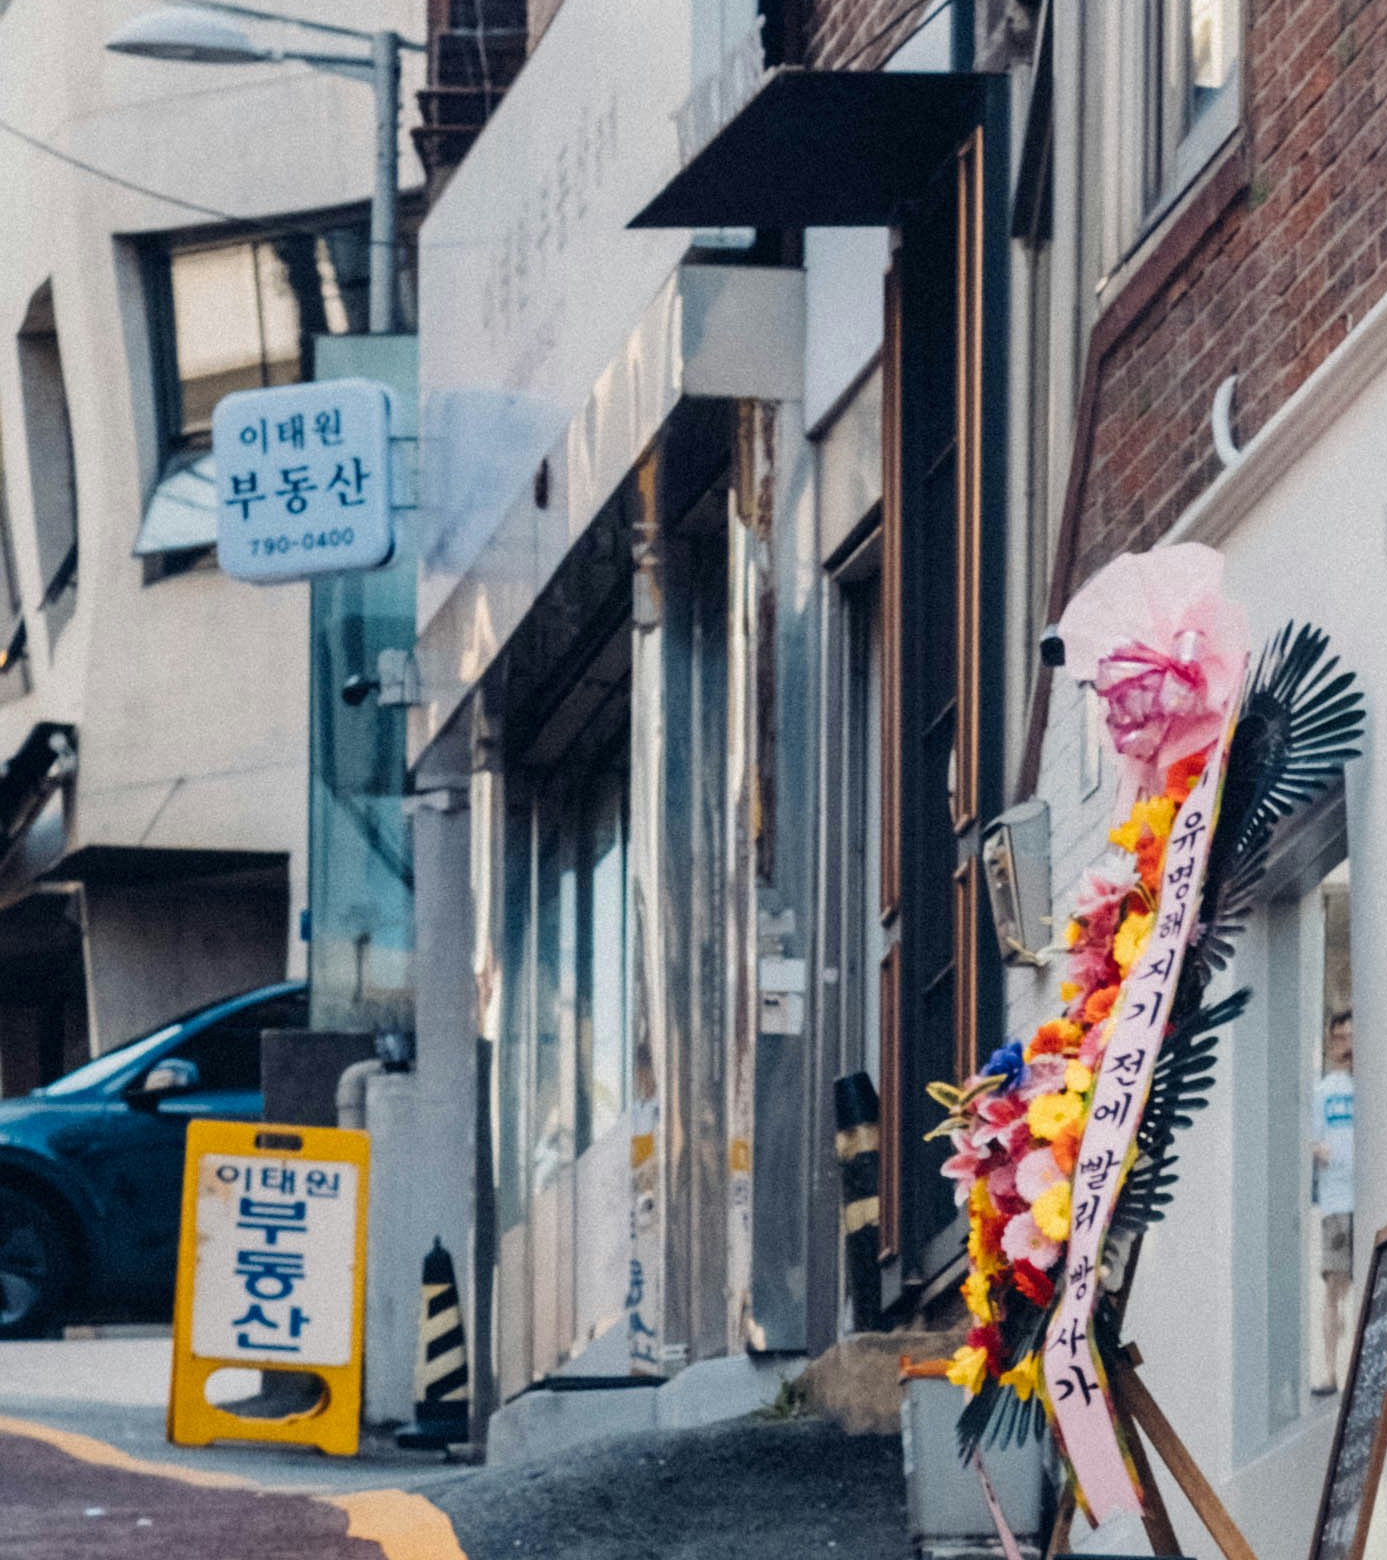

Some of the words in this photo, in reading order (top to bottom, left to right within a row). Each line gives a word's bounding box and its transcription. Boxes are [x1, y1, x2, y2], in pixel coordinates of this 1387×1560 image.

[239, 407, 345, 455] 이태원
[224, 456, 371, 521] 부동산
[251, 527, 355, 557] 790-0400
[1093, 1048, 1145, 1130] 전에
[216, 1164, 341, 1199] 이태원
[231, 1197, 311, 1353] 부동산
